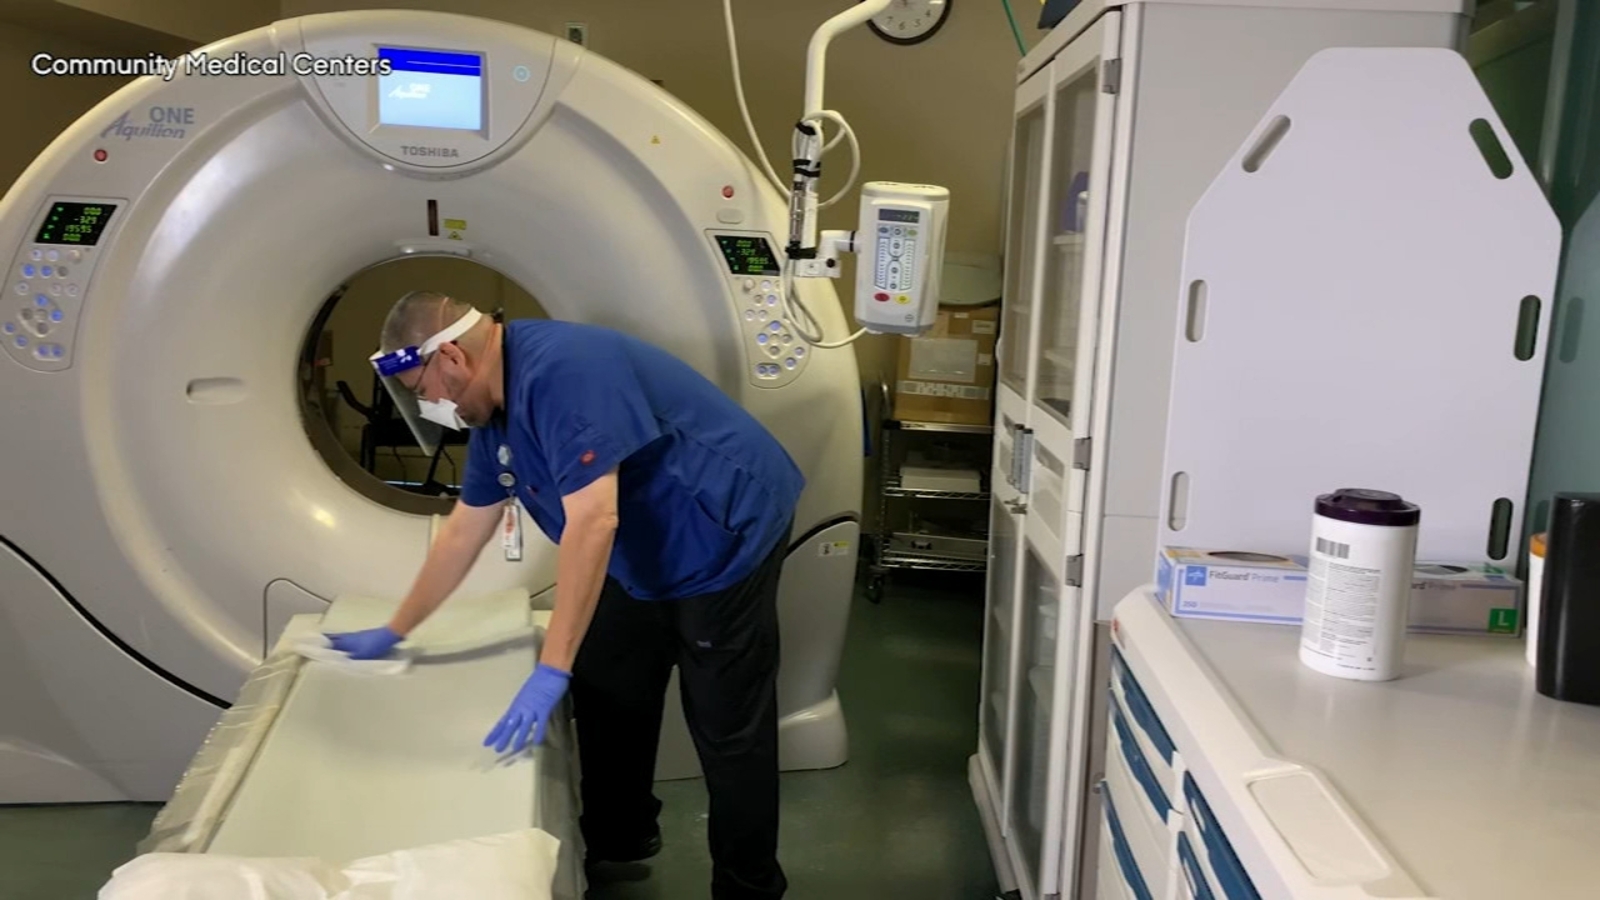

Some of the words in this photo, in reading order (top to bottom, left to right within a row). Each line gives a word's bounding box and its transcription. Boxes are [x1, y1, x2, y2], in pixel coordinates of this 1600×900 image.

[150, 106, 195, 125] ONE
[101, 110, 186, 141] Aquilion
[400, 145, 459, 158] TOSHIBA
[1498, 610, 1509, 626] L
